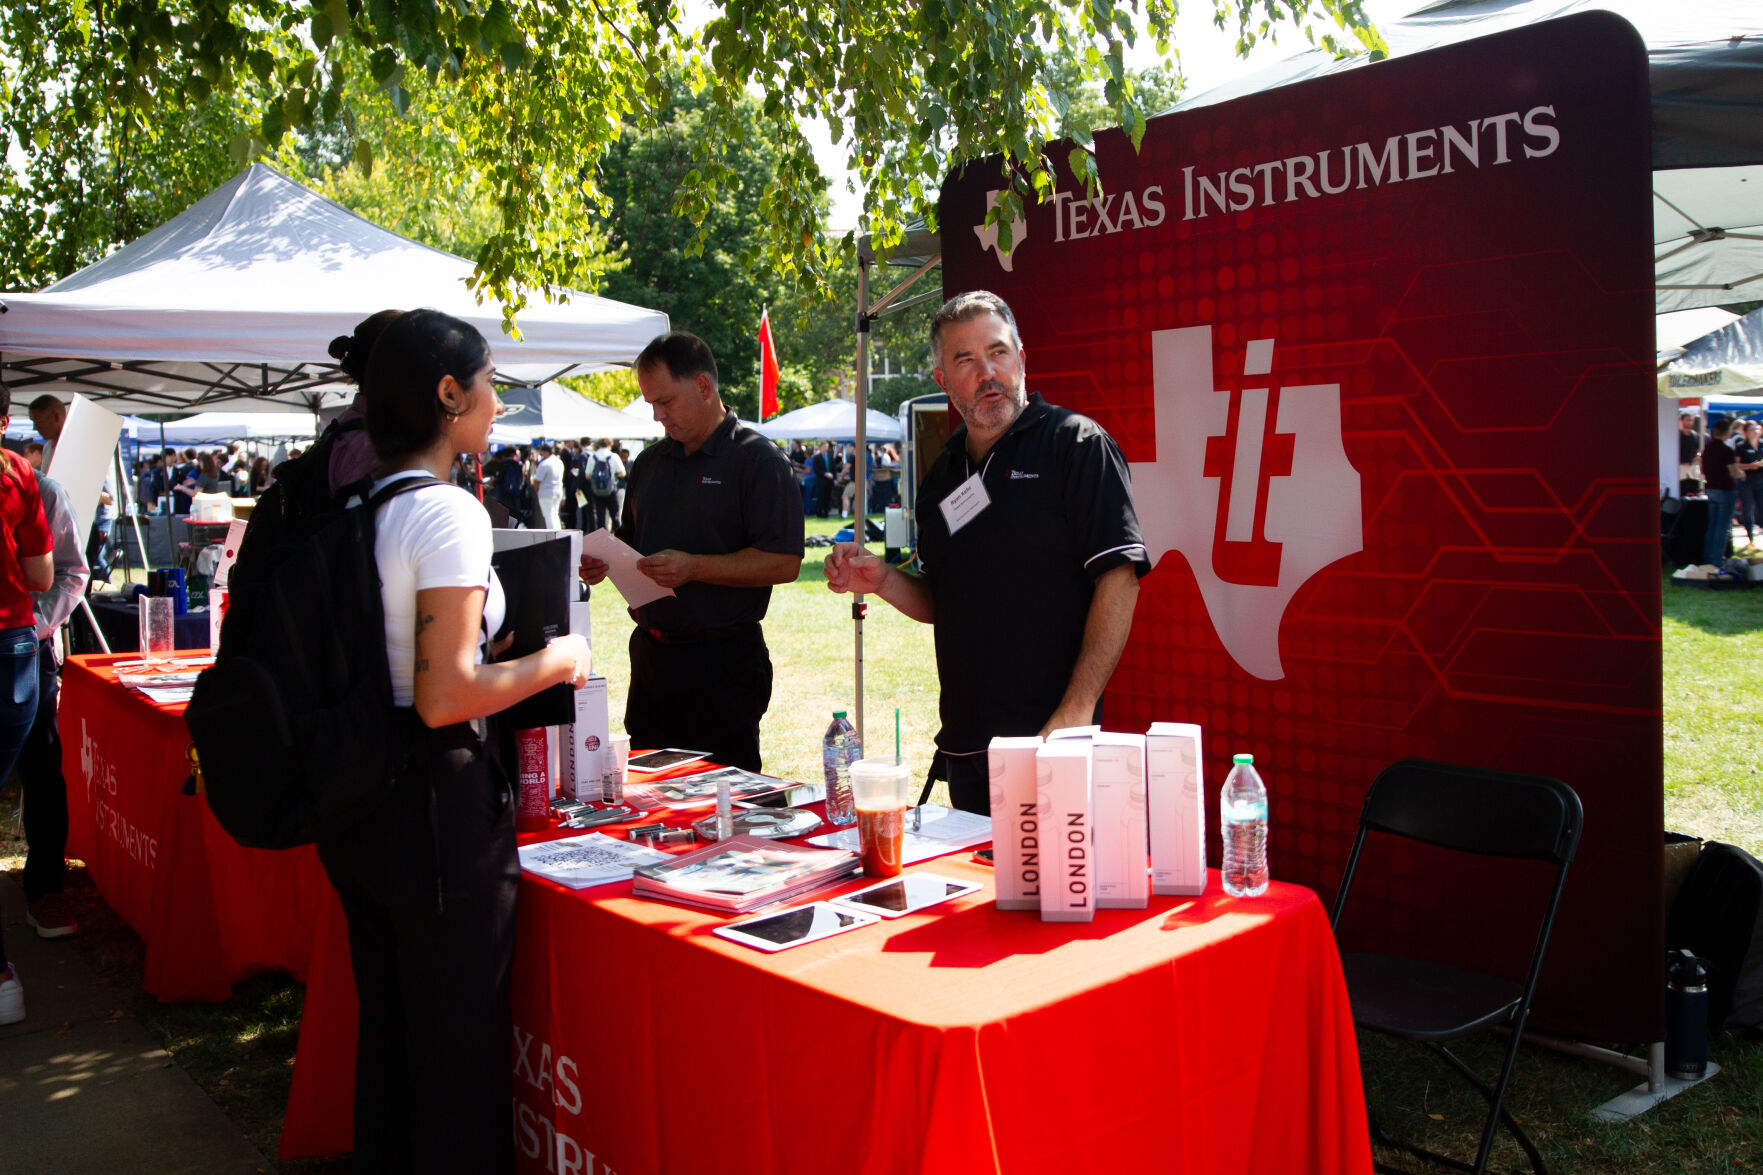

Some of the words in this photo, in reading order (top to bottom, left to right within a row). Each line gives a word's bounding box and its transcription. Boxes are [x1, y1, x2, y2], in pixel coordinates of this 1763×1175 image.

[1044, 185, 1166, 243] TEXAS
[1181, 105, 1561, 221] INSTRUMENTS
[92, 742, 117, 796] TEXAS
[568, 723, 576, 792] LONDON
[95, 790, 158, 869] STRUMENTS
[1020, 802, 1040, 896] LONDON
[1067, 812, 1087, 908] LONDON
[512, 1024, 582, 1115] XAS
